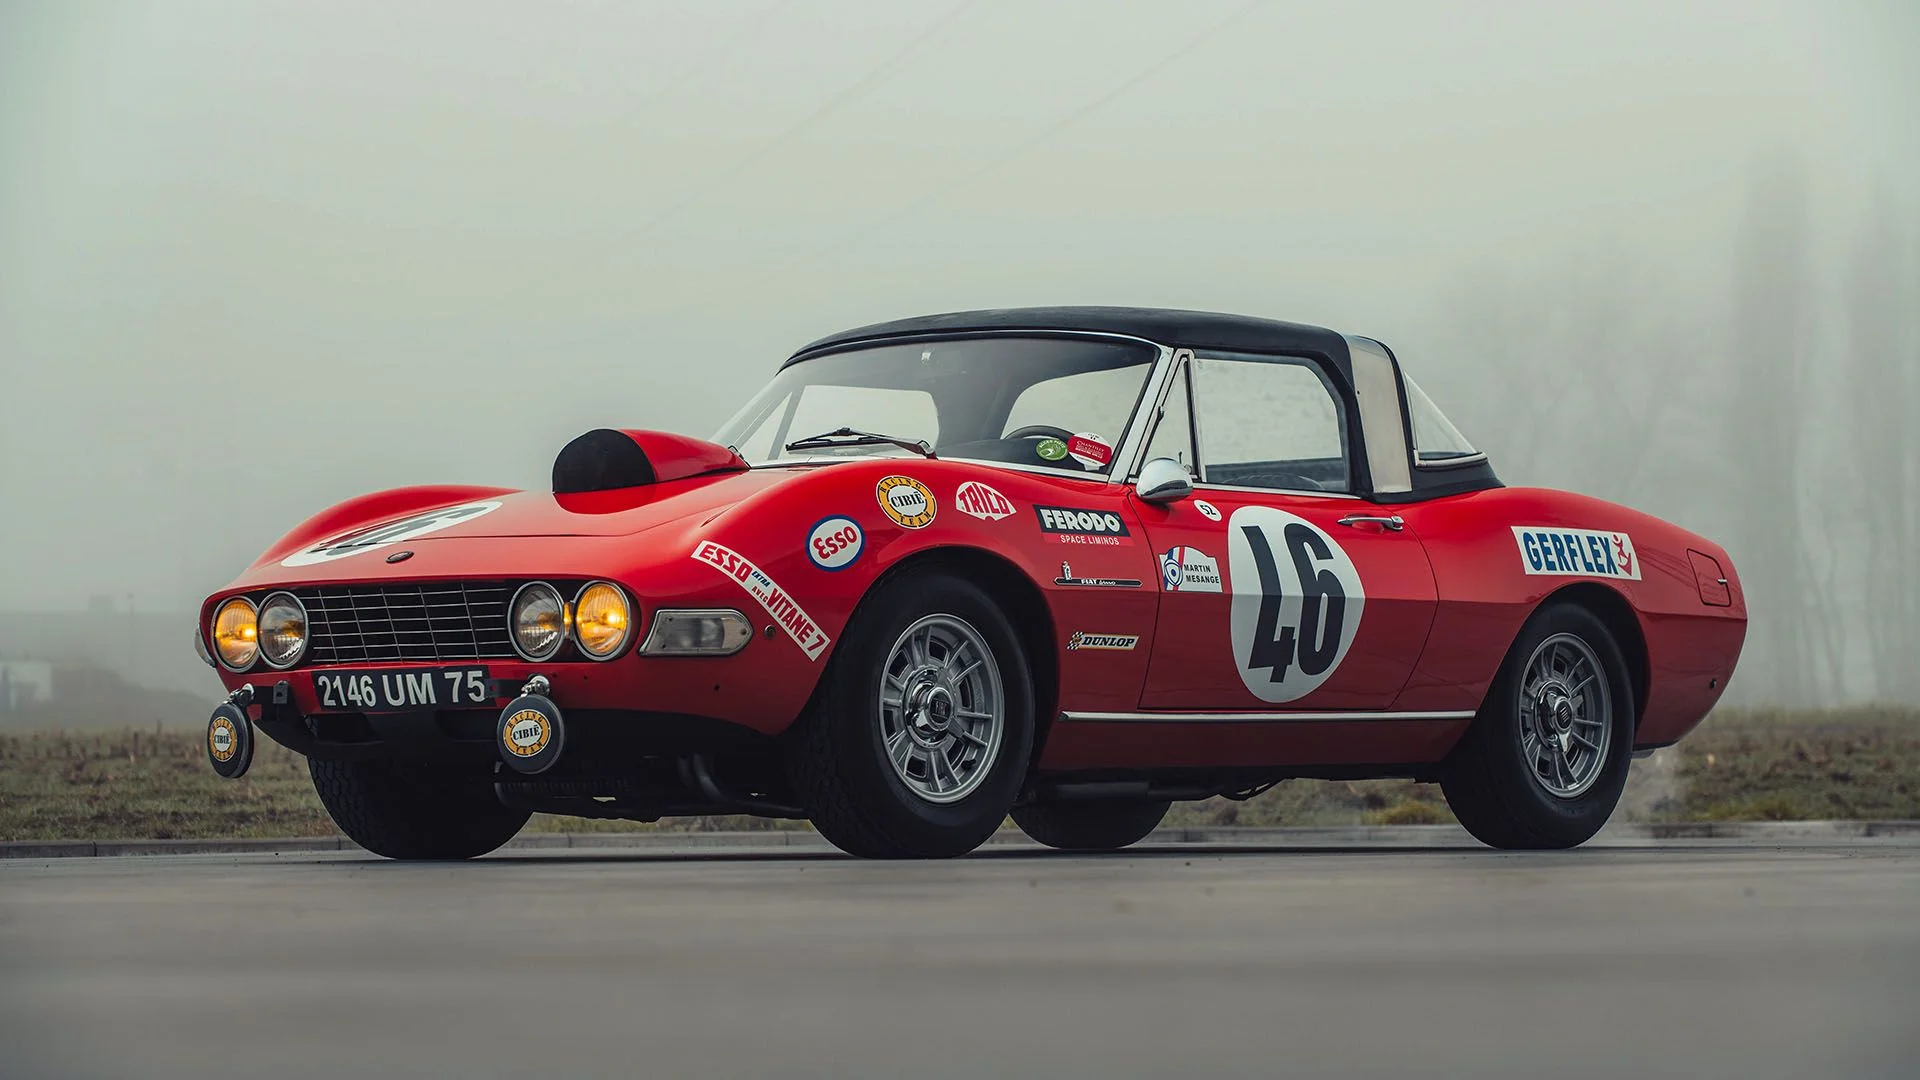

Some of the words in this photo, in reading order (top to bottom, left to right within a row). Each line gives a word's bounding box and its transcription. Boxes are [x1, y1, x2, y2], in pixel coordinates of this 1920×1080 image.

[957, 482, 1012, 515] TRICO
[1039, 508, 1121, 533] FERODO
[1060, 534, 1087, 544] SPACE
[1087, 536, 1120, 546] LIMINOS
[1522, 532, 1619, 575] GERFLEX
[698, 544, 753, 583] ESSO
[1183, 564, 1211, 573] MARTIN
[1185, 574, 1220, 584] MESANGE
[751, 586, 769, 603] AVEC
[766, 587, 815, 645] VITANE
[806, 633, 826, 652] 7
[1240, 522, 1346, 683] 46
[1081, 636, 1136, 647] DUNLOP
[318, 674, 377, 707] 2146
[382, 672, 437, 707] UM
[444, 670, 486, 703] 75
